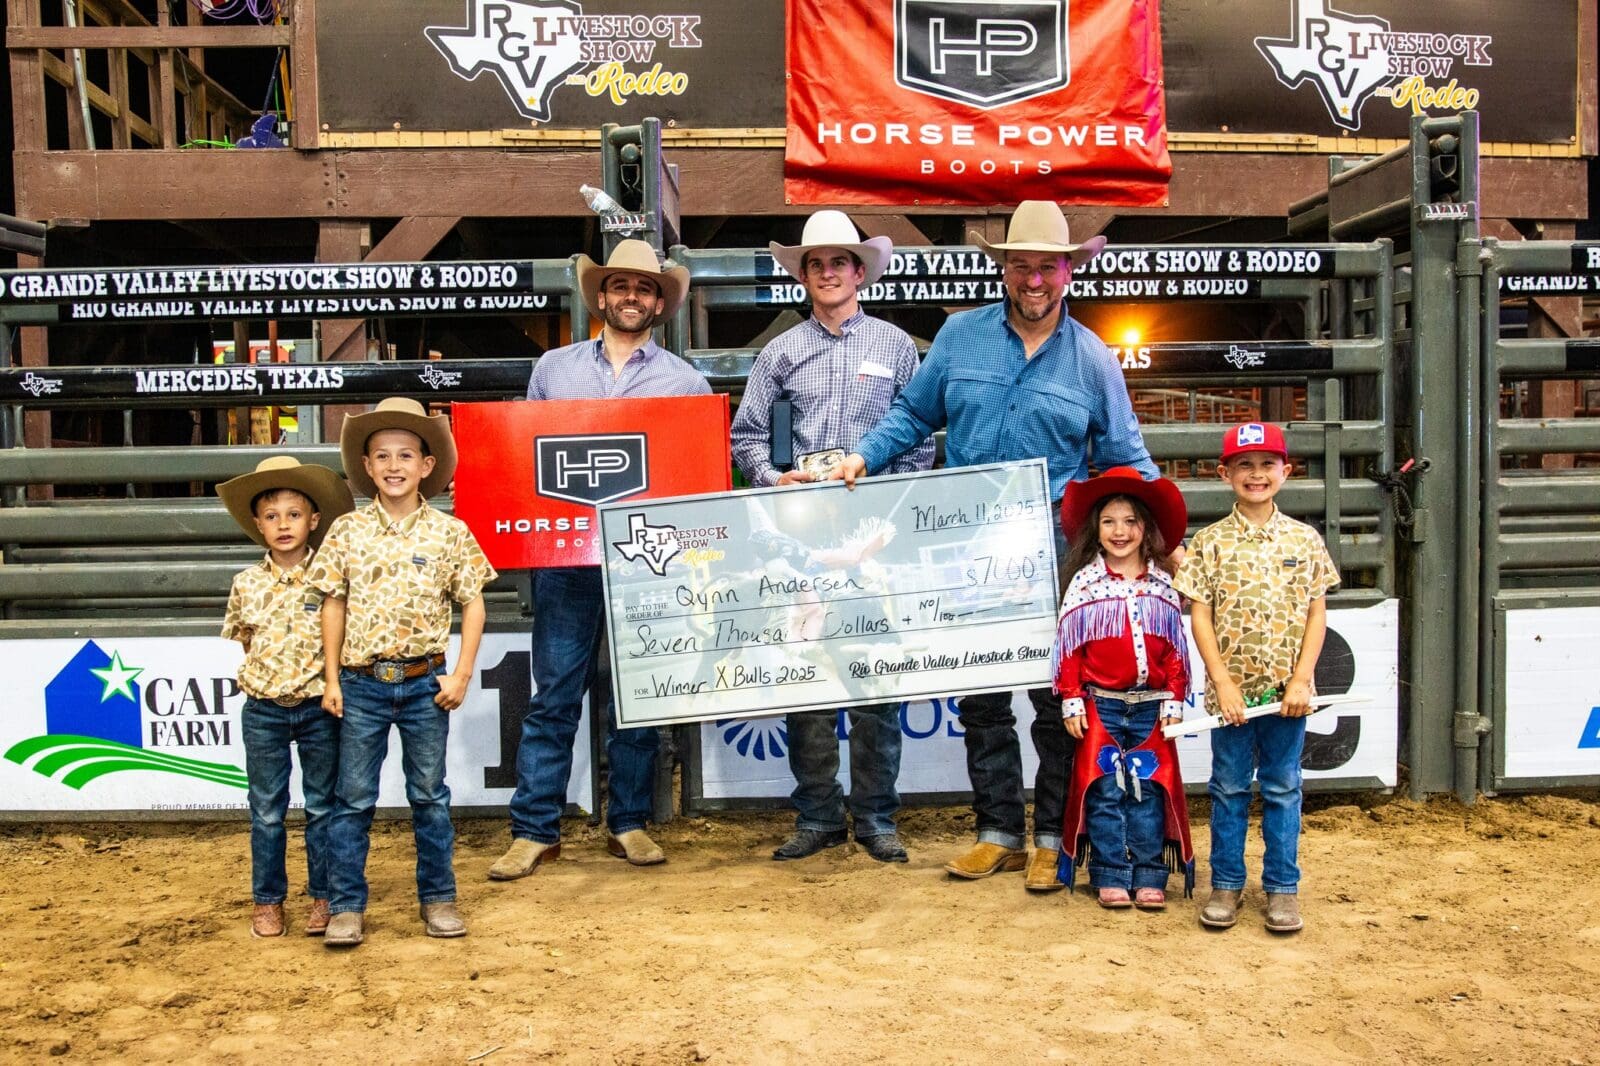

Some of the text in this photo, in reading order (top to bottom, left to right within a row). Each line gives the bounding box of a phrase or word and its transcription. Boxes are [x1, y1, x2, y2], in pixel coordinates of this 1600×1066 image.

[533, 16, 701, 46] LIVESTOCK
[579, 41, 654, 62] SHOW
[929, 18, 1038, 76] HP
[1348, 32, 1492, 65] LIVESTOCK
[1387, 57, 1452, 77] SHOW
[585, 62, 688, 105] Rodeo
[1391, 76, 1479, 116] Rodeo
[818, 123, 1147, 147] HORSE POWER
[921, 160, 1052, 174] BOOTS
[922, 253, 1005, 276] VALLE
[1155, 251, 1222, 273] SHOW
[1228, 251, 1241, 272] &
[1246, 250, 1321, 273] RODEO
[10, 274, 108, 298] GRANDE
[112, 271, 202, 294] VALLEY
[207, 267, 341, 292] LIVESTOCK
[345, 265, 415, 289] SHOW
[421, 266, 434, 288] &
[440, 265, 518, 288] RODEO
[770, 284, 806, 304] RIO
[900, 281, 977, 300] VALLEY
[1103, 279, 1162, 297] SHOW
[1166, 279, 1178, 296] &
[1183, 278, 1249, 296] RODEO
[72, 302, 107, 318] RIO
[111, 300, 195, 318] GRANDE
[201, 299, 275, 315] VALLEY
[281, 296, 395, 313] LIVESTOCK
[136, 366, 344, 395] MERCEDES, TEXAS
[556, 449, 630, 489] HP
[495, 517, 590, 533] HORSE
[912, 504, 971, 531] March
[556, 538, 600, 548] BOO
[657, 526, 729, 546] LIVESTOCK
[677, 538, 709, 550] SHOW
[676, 575, 864, 611] Qynn Andersen
[625, 605, 639, 613] PAY
[652, 602, 669, 610] THE
[625, 611, 652, 620] ORDER
[629, 625, 697, 656] Seven
[848, 645, 1051, 679] Rio Grande Valley Livestock Show
[634, 688, 649, 696] FOR
[652, 665, 817, 698] Winner X Bulls 2025
[150, 720, 231, 747] FARM
